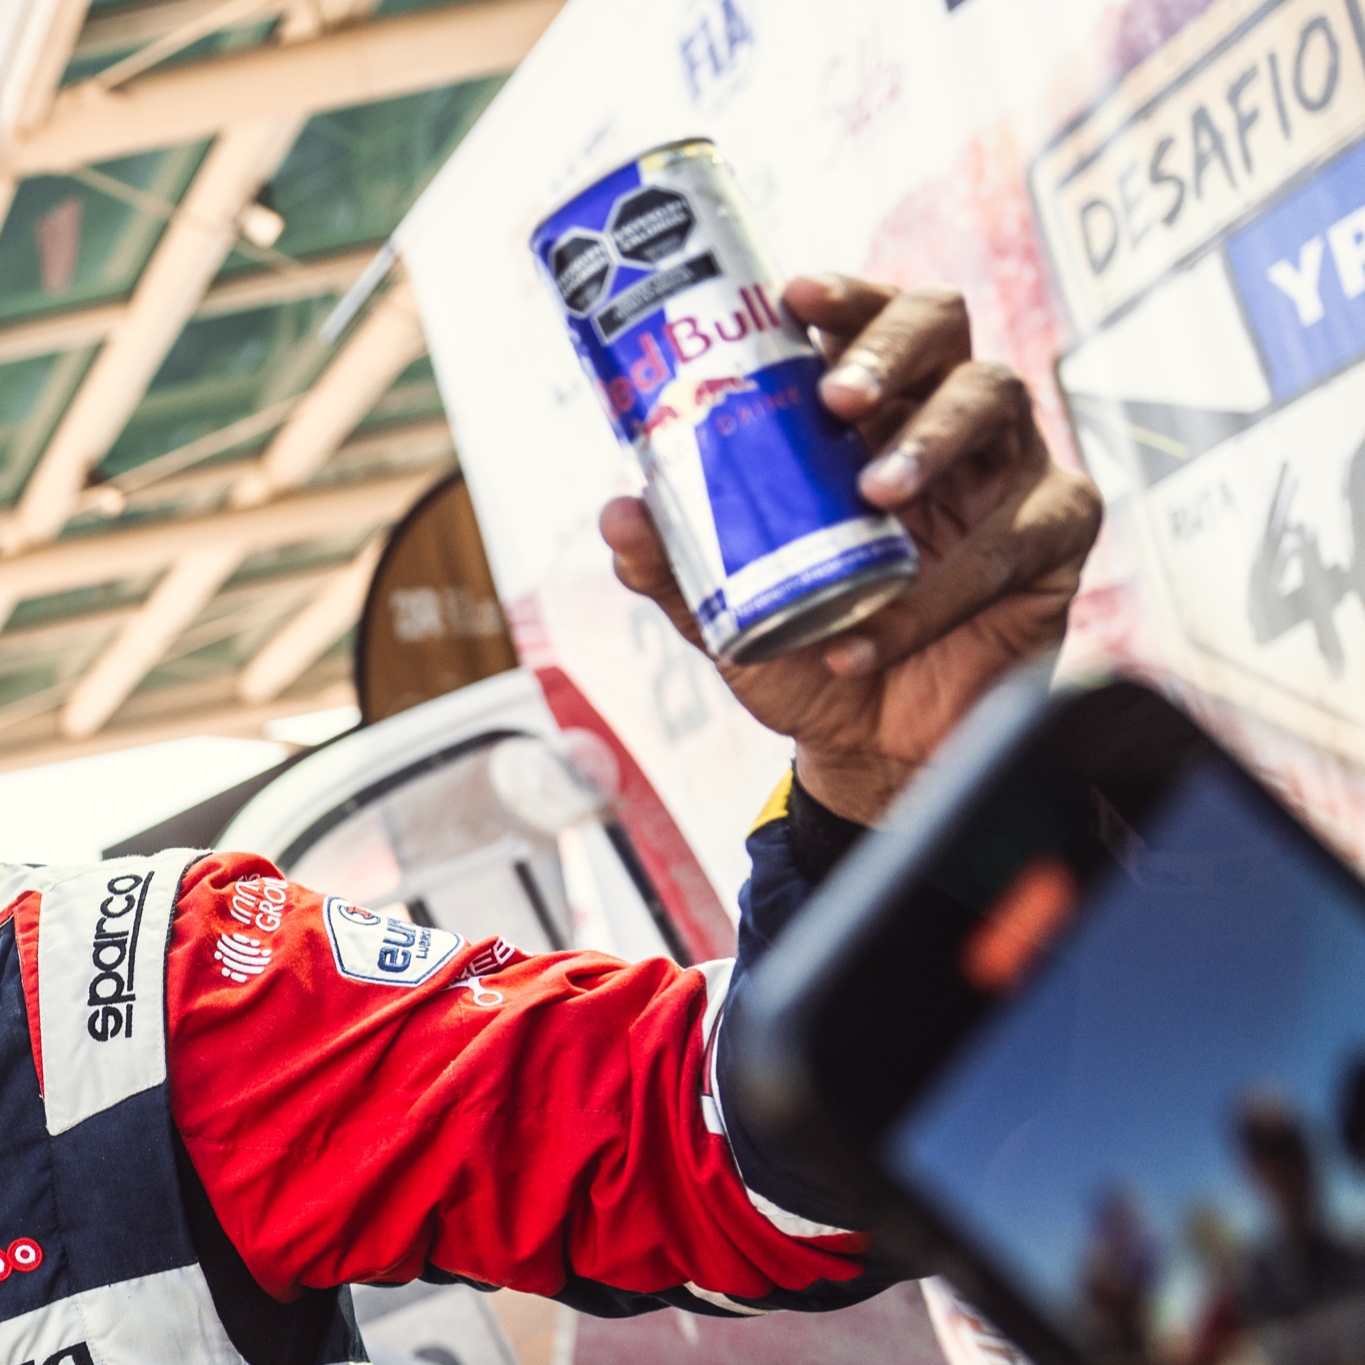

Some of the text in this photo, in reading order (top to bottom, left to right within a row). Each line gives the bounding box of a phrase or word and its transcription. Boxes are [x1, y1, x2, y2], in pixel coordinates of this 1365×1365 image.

[1079, 14, 1340, 276] DESAFIO
[663, 283, 782, 364] Bull
[87, 873, 143, 1042] sparco
